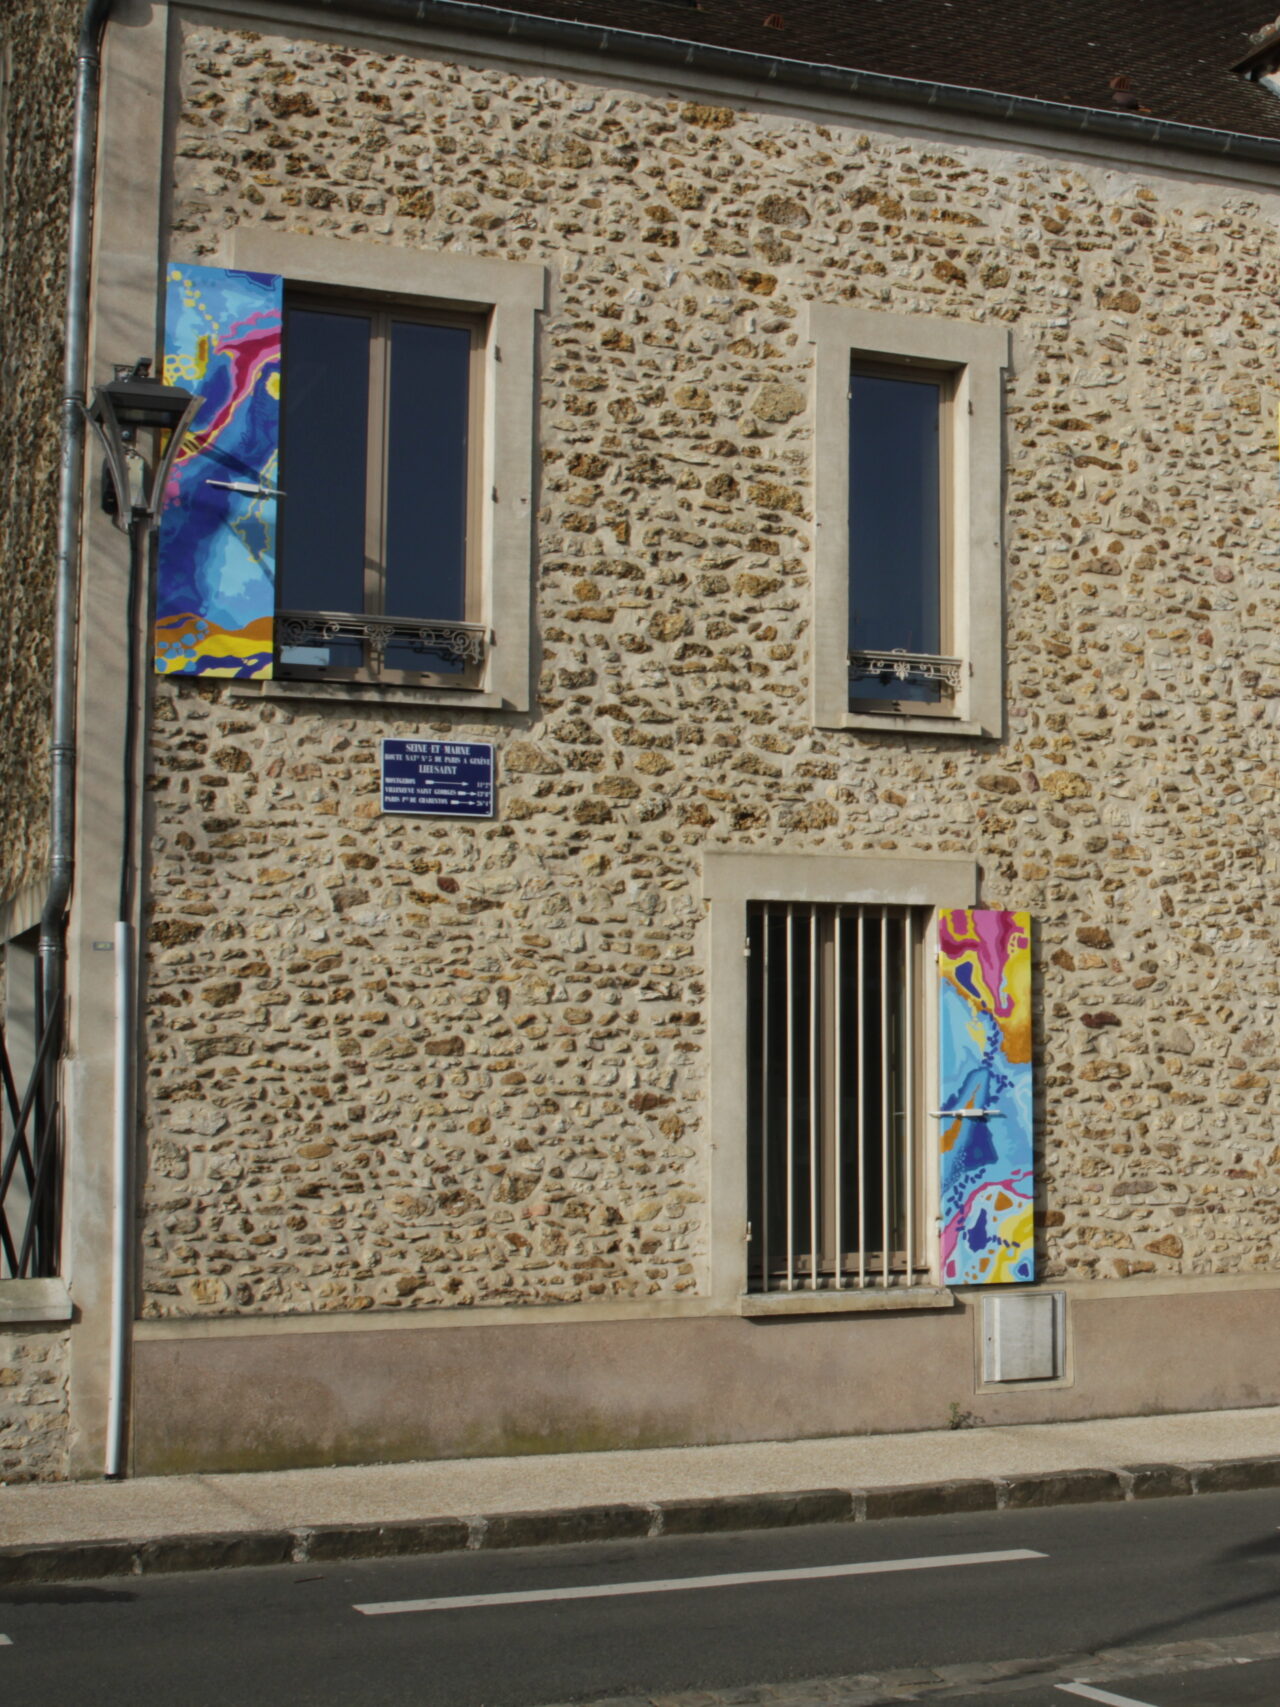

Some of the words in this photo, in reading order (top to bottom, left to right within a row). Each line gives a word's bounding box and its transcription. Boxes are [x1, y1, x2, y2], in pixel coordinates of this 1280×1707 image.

[405, 744, 427, 753] SEINE
[431, 745, 440, 754] ET
[444, 746, 471, 756] MARNE
[384, 753, 403, 761] ROUTE
[444, 756, 460, 764] PARIS
[418, 764, 458, 775] LIEUSAINT
